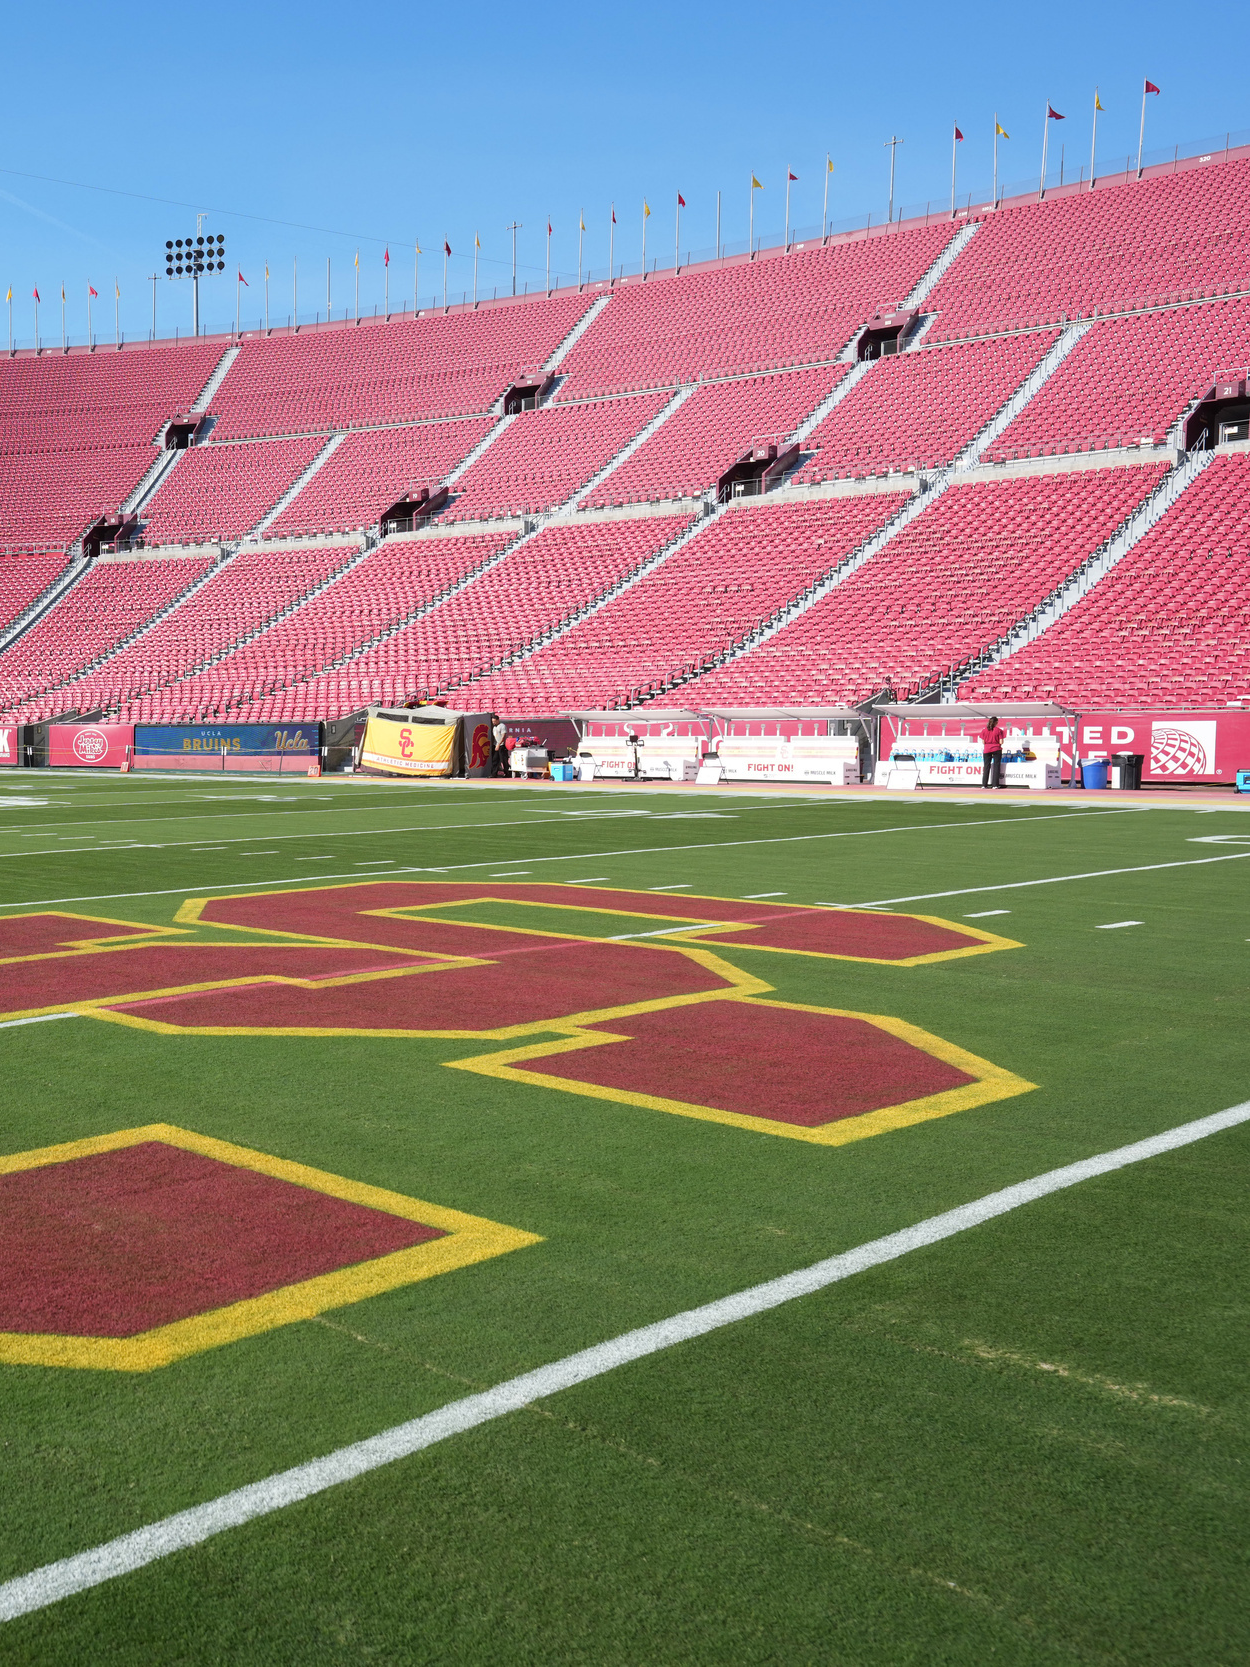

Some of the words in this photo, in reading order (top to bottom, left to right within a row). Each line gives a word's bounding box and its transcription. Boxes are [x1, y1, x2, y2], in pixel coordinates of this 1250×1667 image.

[1223, 386, 1232, 395] 21
[998, 726, 1135, 745] NITED
[182, 738, 241, 751] BRUINS
[376, 756, 403, 766] ATHLETIC
[601, 760, 626, 769] FIGHT
[309, 766, 318, 774] 20
[747, 763, 775, 772] FIGHT
[777, 764, 794, 772] ON!
[929, 765, 963, 774] FIGHT
